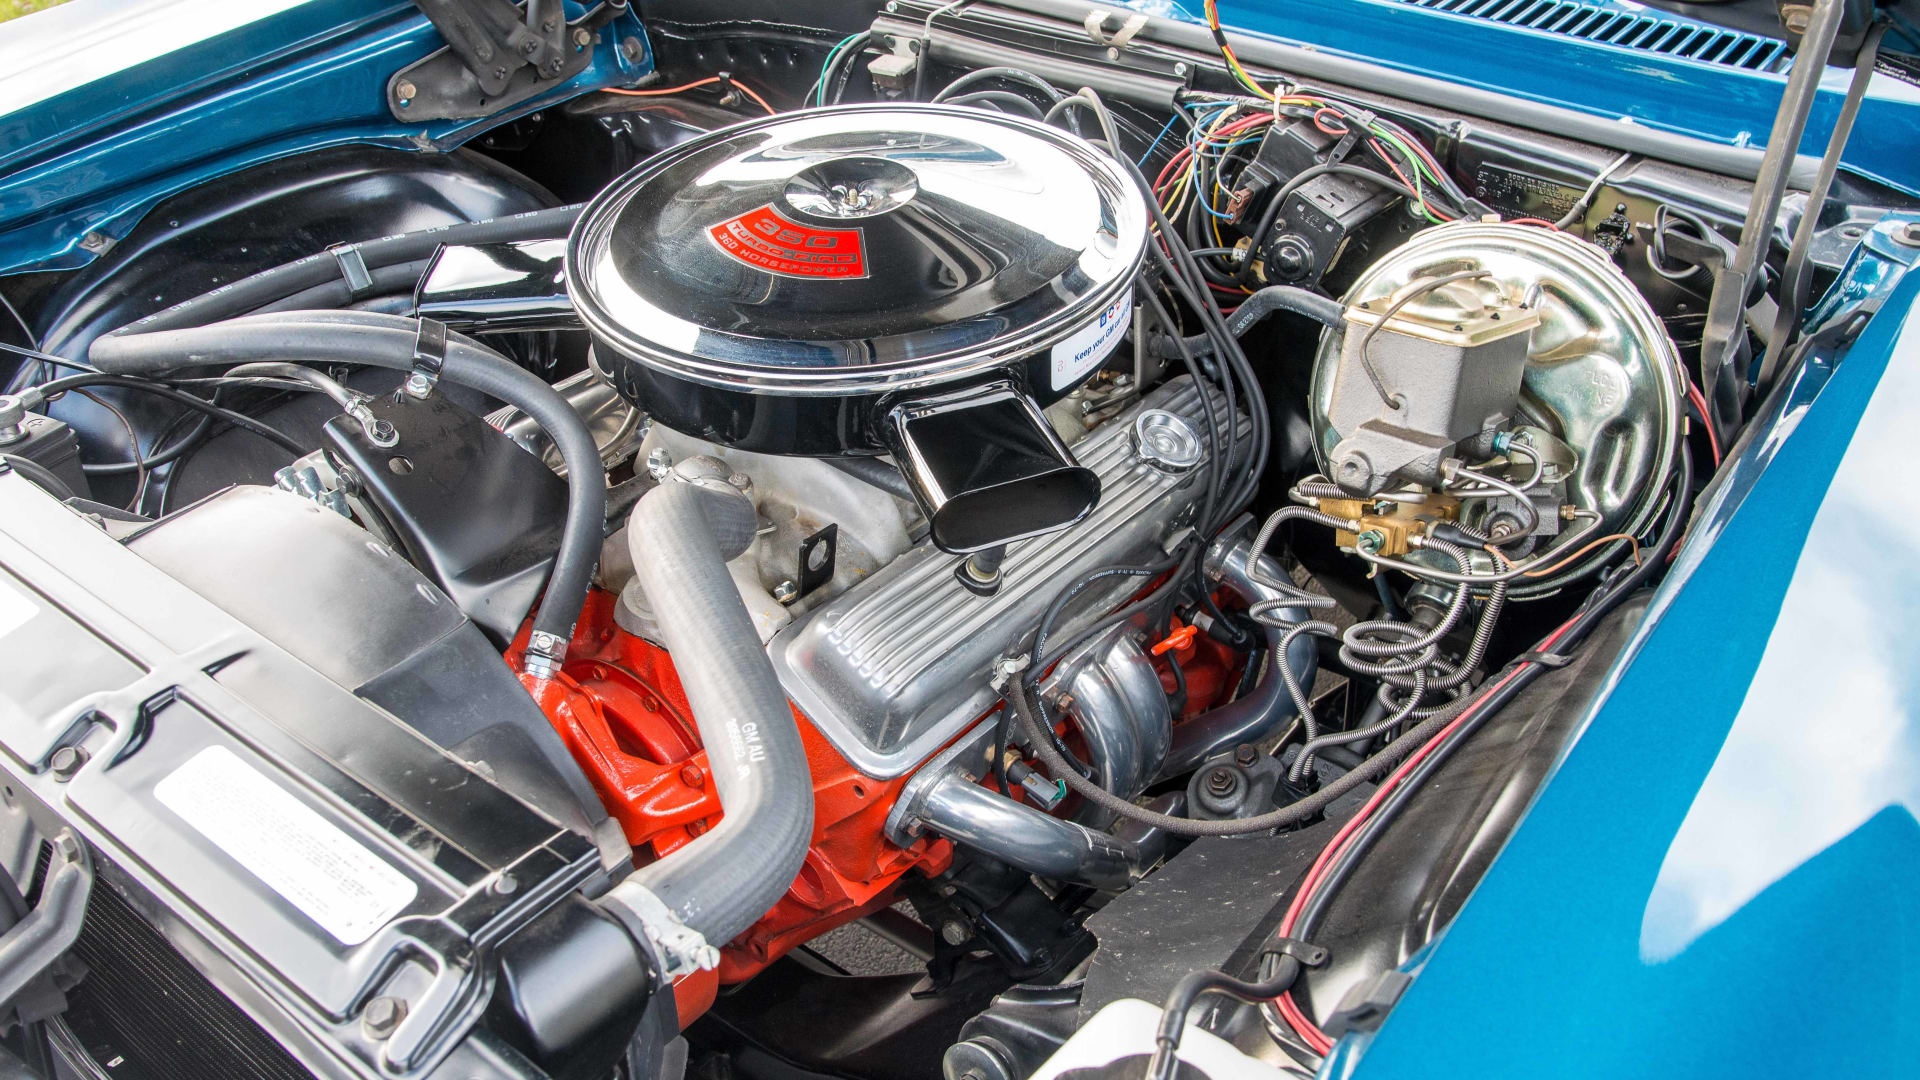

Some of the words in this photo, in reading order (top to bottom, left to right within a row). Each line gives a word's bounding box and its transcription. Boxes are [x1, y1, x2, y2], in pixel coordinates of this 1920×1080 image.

[727, 221, 857, 263] TURBO-FIRE
[754, 218, 838, 248] 350
[718, 232, 738, 250] 360
[741, 249, 848, 273] HORSEPOWER
[1074, 346, 1092, 363] Keep
[1092, 335, 1105, 351] your
[1105, 324, 1115, 338] GM
[742, 721, 761, 744] GM
[749, 744, 766, 762] AU
